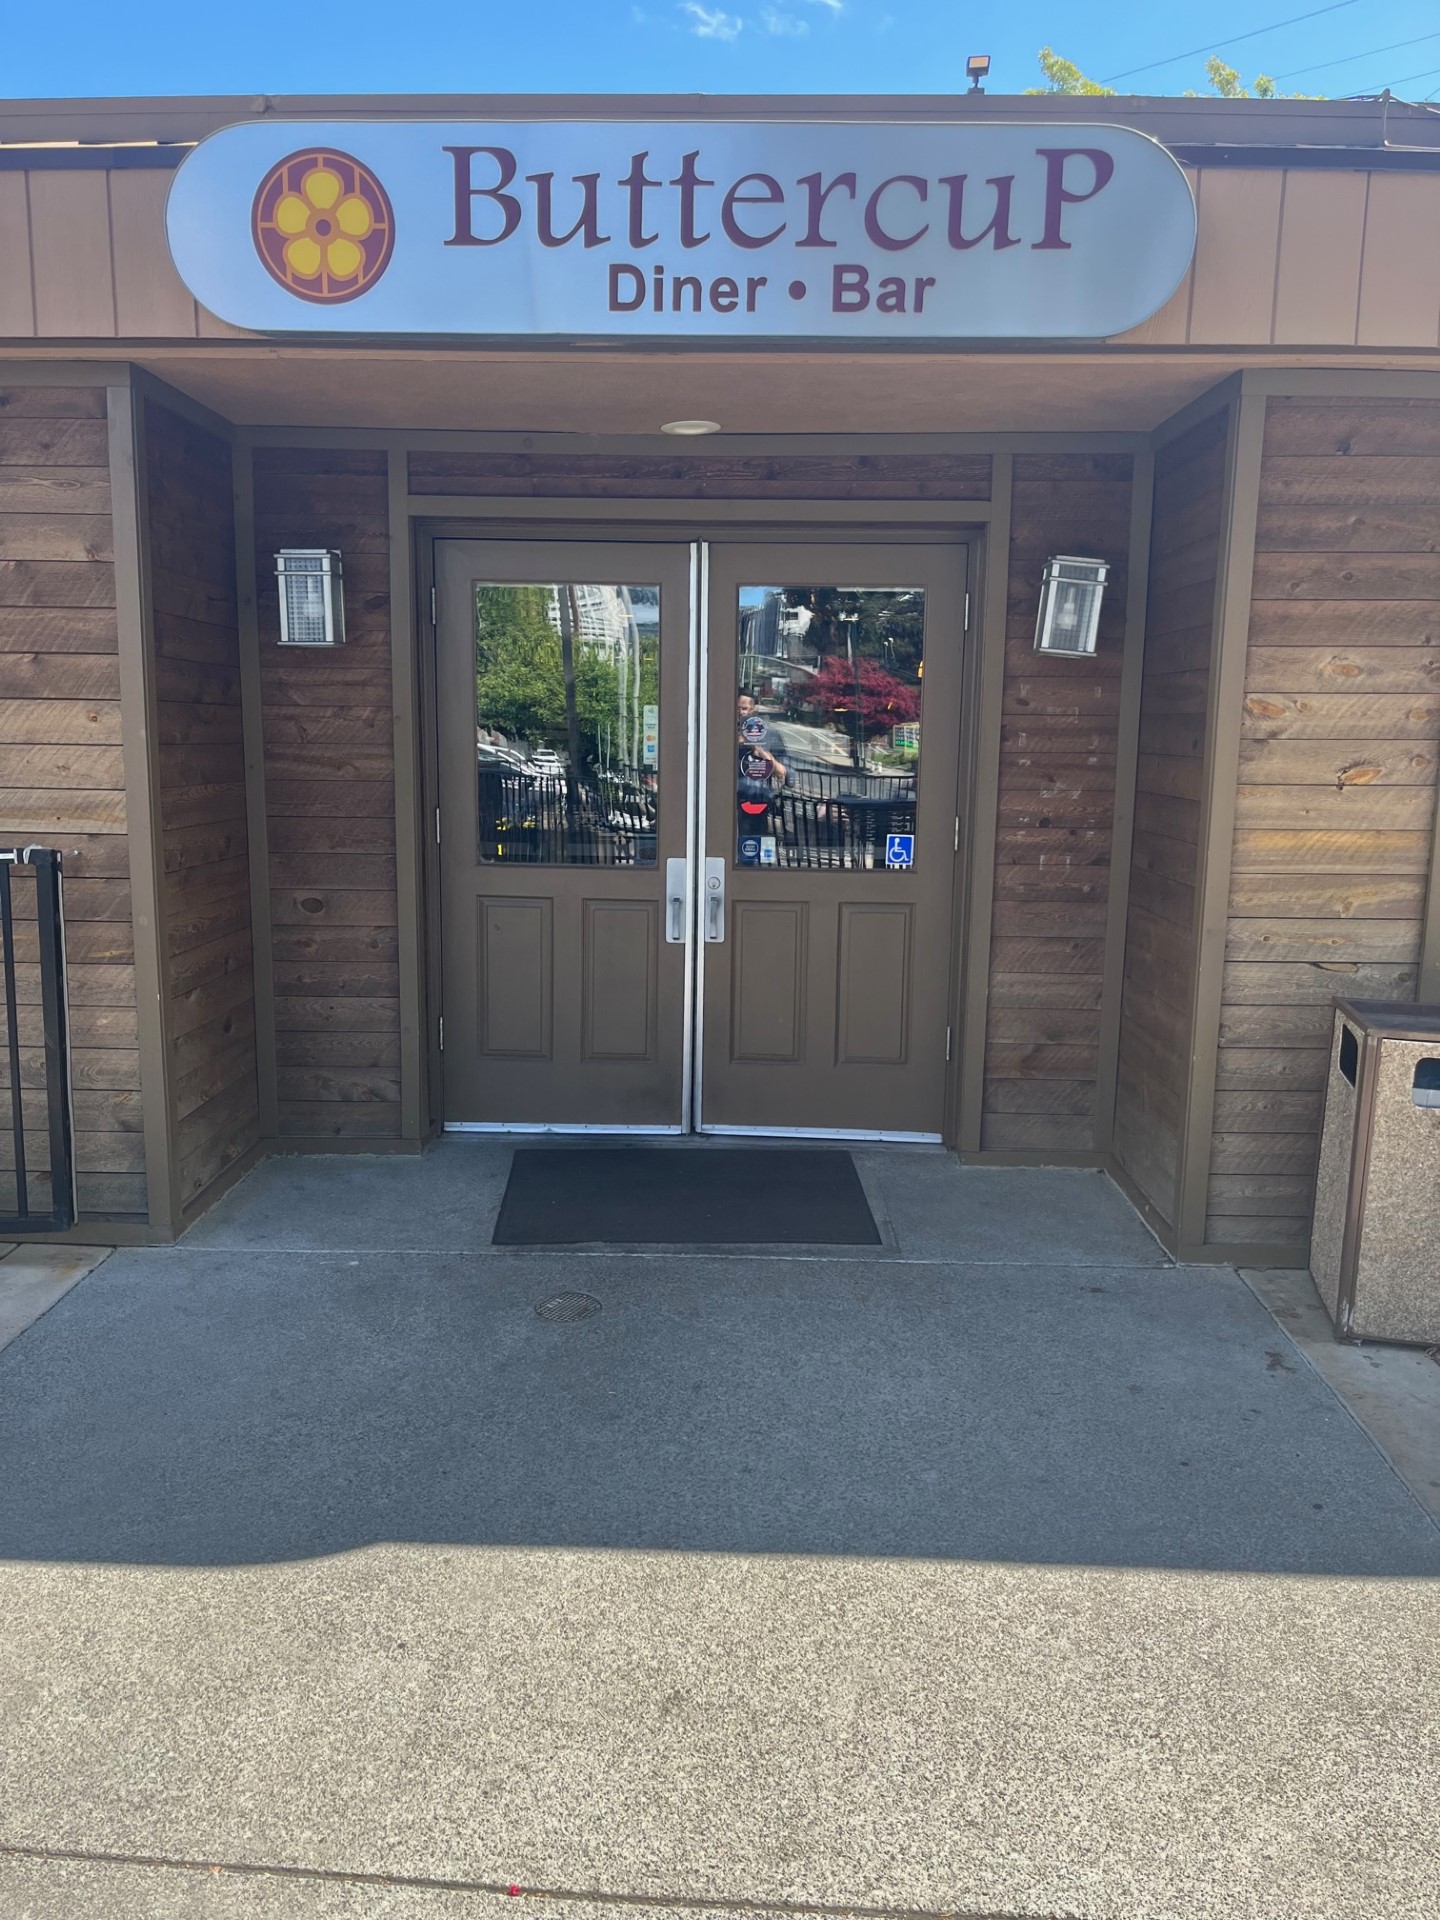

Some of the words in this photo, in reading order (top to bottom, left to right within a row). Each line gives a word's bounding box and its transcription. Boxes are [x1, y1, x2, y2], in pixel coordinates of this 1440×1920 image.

[442, 146, 1115, 252] ButtercuP
[608, 263, 768, 313] Diner
[832, 263, 937, 314] Bar
